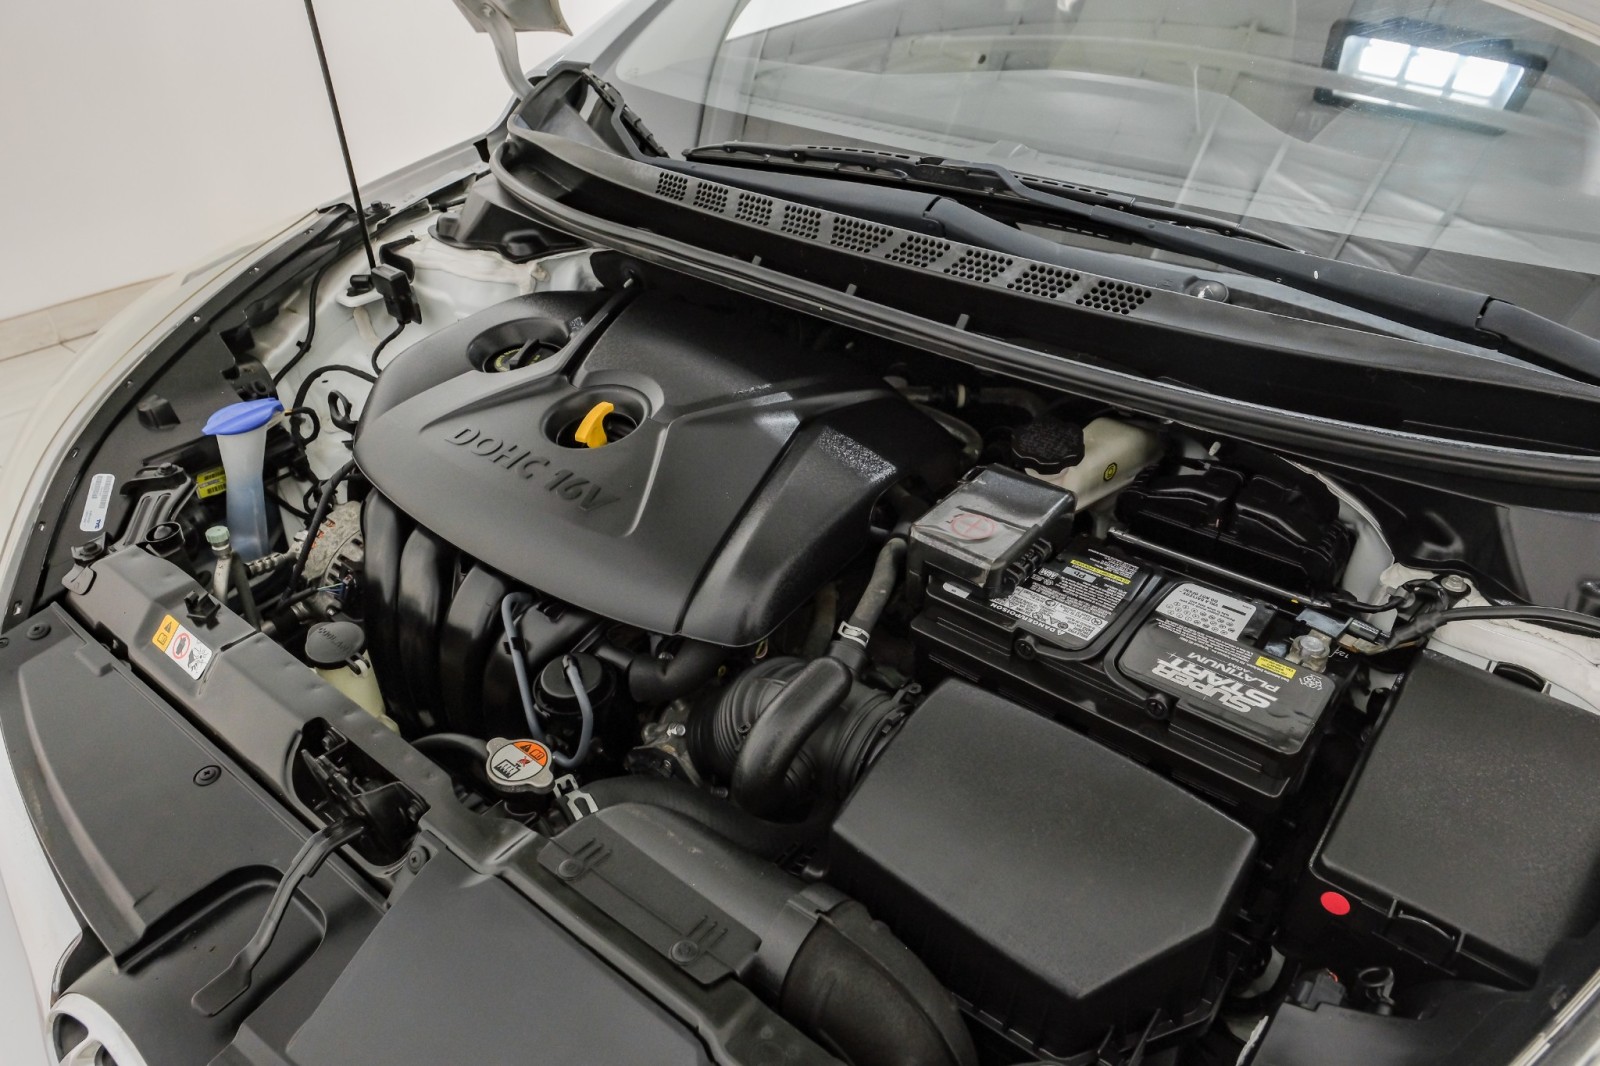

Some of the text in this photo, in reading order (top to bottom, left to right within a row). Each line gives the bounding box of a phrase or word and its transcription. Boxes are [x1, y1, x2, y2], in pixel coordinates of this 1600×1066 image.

[445, 428, 621, 511] DOHC 16V
[1073, 570, 1087, 579] Pb
[990, 603, 1056, 633] DANGER/POISON
[1157, 657, 1278, 709] START
[1187, 652, 1281, 693] PLATINUM
[1227, 662, 1247, 673] AGM
[1151, 664, 1252, 713] SUPER
